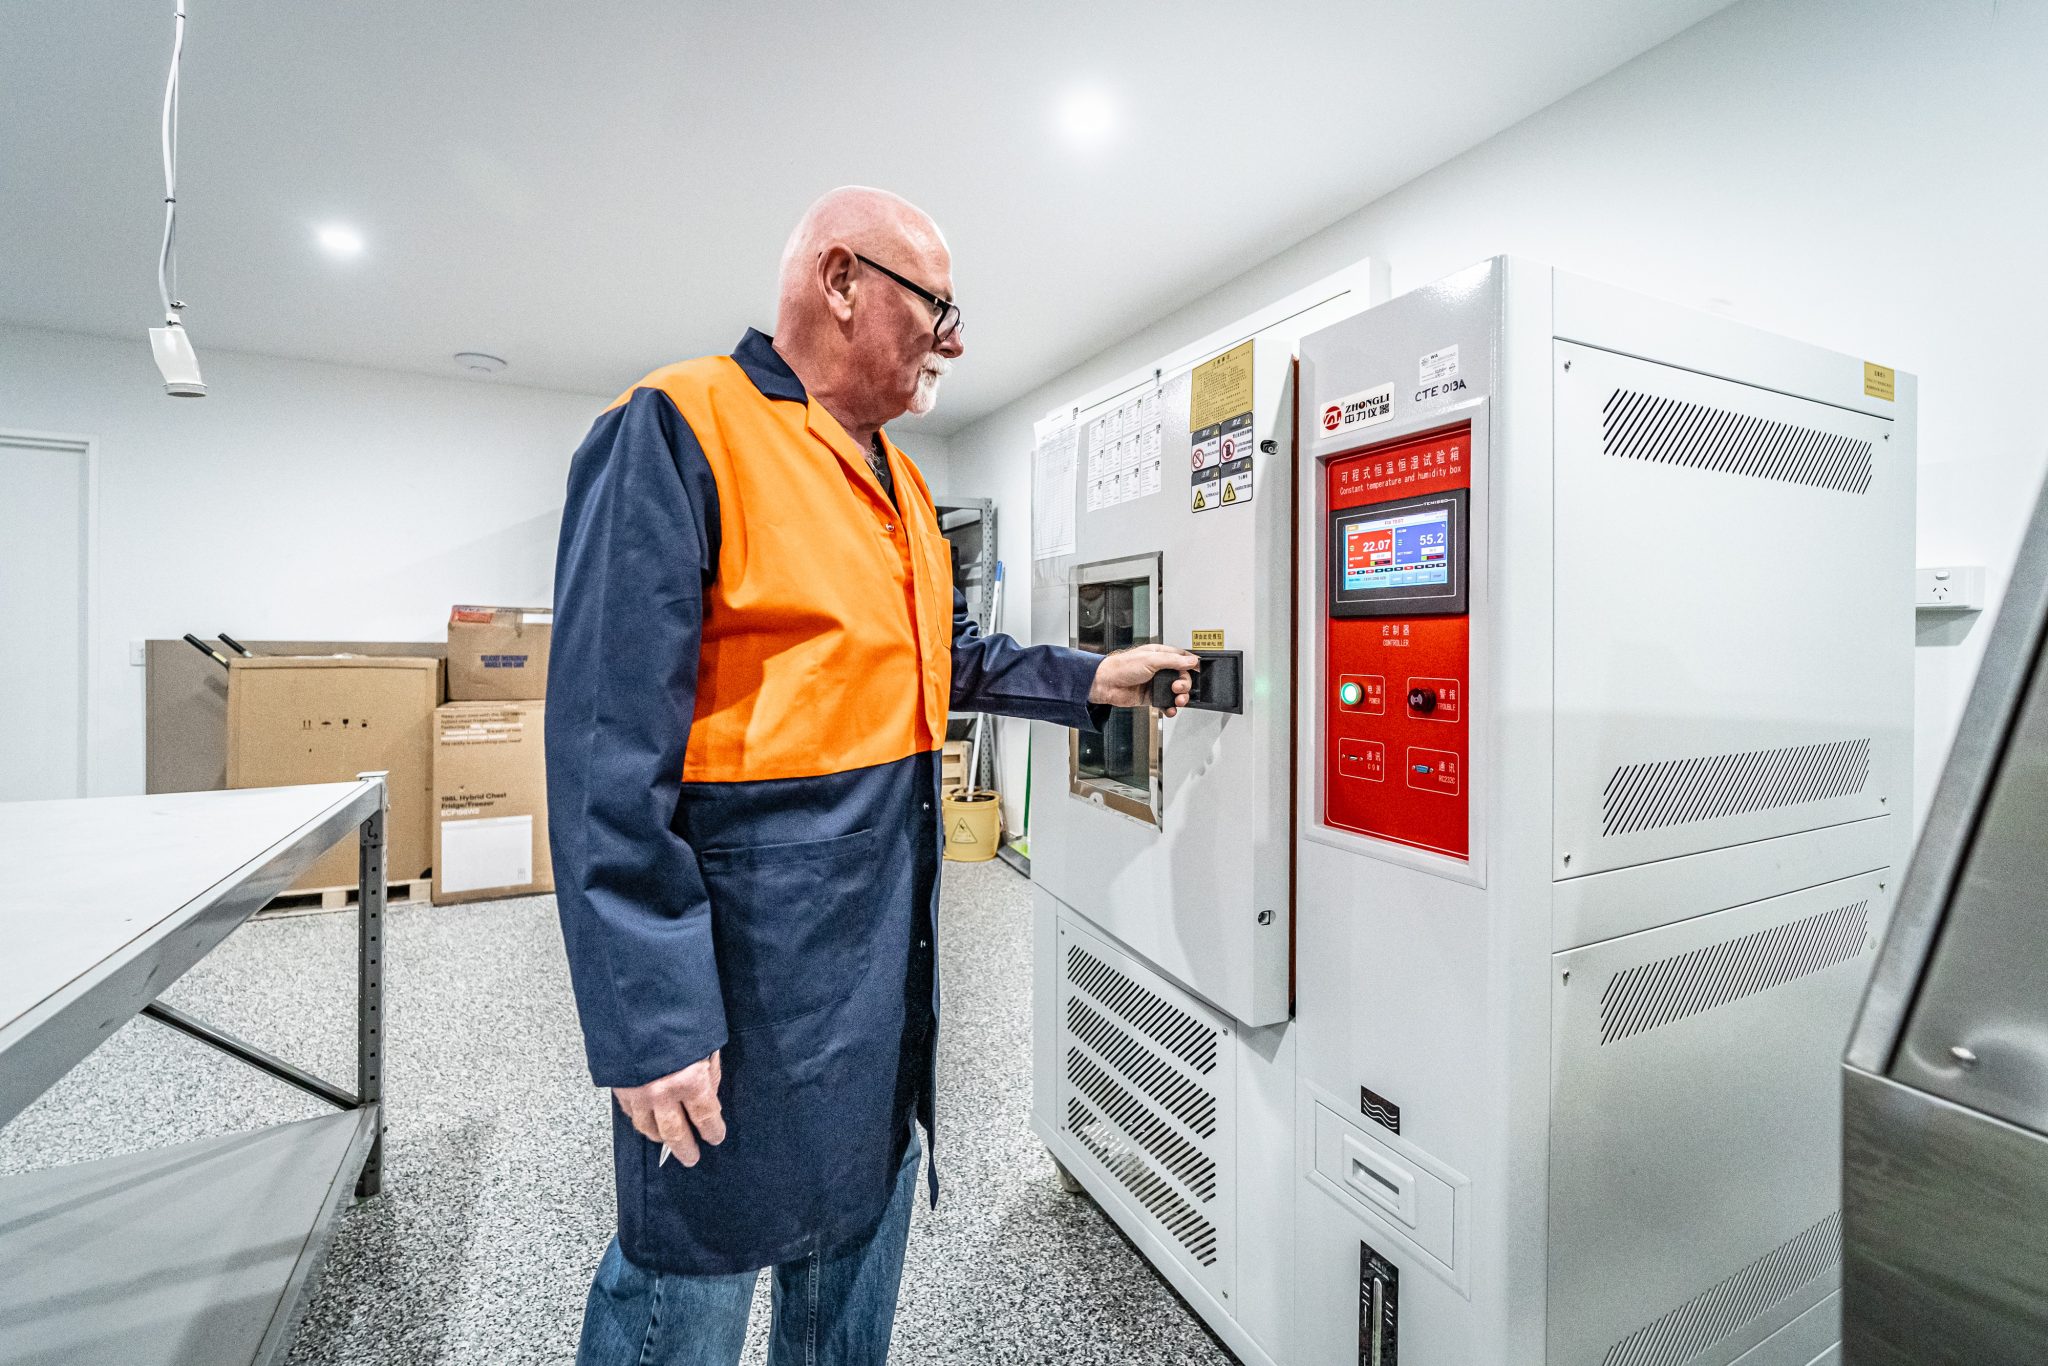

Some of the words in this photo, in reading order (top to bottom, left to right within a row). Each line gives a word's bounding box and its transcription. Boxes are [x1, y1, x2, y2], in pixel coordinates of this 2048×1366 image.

[1415, 386, 1439, 402] CTE
[1442, 379, 1467, 394] 013A
[1345, 393, 1390, 413] ZHONGLI
[1344, 403, 1390, 425] 中力仪器
[1341, 446, 1459, 484] 可程式恒温恒湿试验箱
[1340, 484, 1364, 495] Constant
[1366, 477, 1402, 490] temperature
[1404, 473, 1415, 483] and
[1417, 466, 1446, 480] humidity
[1449, 464, 1461, 474] box
[1362, 539, 1391, 553] 22.07
[1419, 533, 1444, 546] 55.2
[1382, 624, 1409, 636] 控制器
[1383, 639, 1409, 647] CONTROLLER
[1437, 702, 1456, 711] TROUBLE
[1366, 750, 1381, 762] 通讯
[1438, 761, 1456, 774] 通讯
[460, 793, 484, 802] Hybrid
[441, 801, 494, 810] Fridge/Freezer
